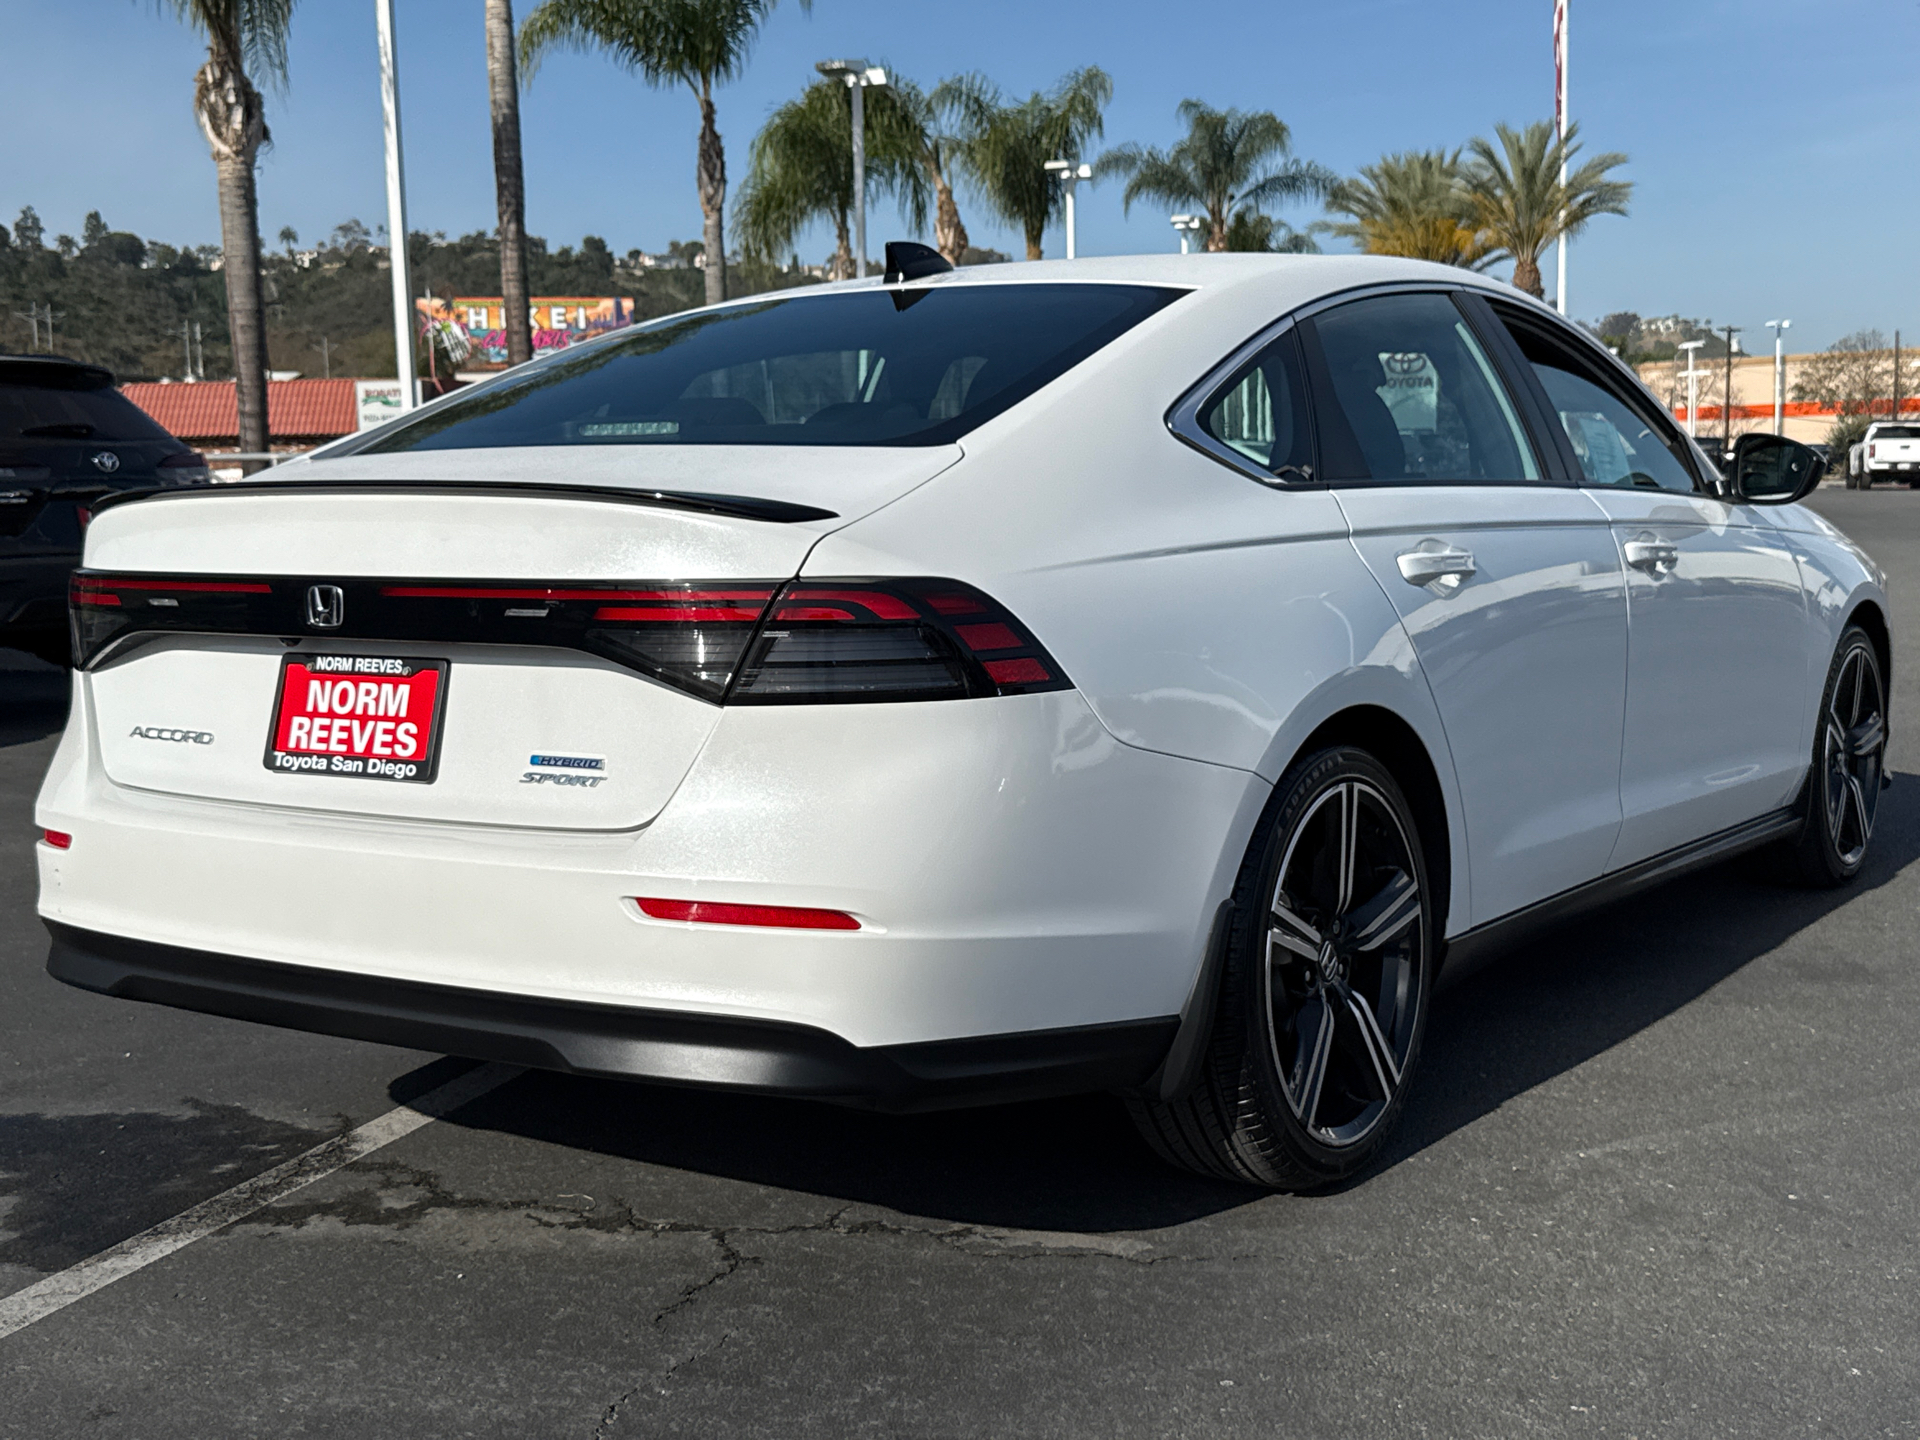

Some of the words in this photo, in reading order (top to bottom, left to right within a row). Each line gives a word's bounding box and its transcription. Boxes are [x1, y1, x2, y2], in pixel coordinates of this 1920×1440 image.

[483, 329, 572, 350] CAABIS
[1387, 376, 1434, 389] OYOTA
[315, 656, 353, 672] NORM
[354, 658, 404, 674] REEVES
[306, 679, 411, 718] NORM
[129, 726, 215, 745] ACCORD
[287, 715, 419, 757] REEVES
[273, 751, 328, 771] Toyota
[331, 755, 364, 772] San
[366, 758, 417, 779] Diego
[538, 755, 603, 768] HYBRID
[519, 772, 608, 788] SPORT
